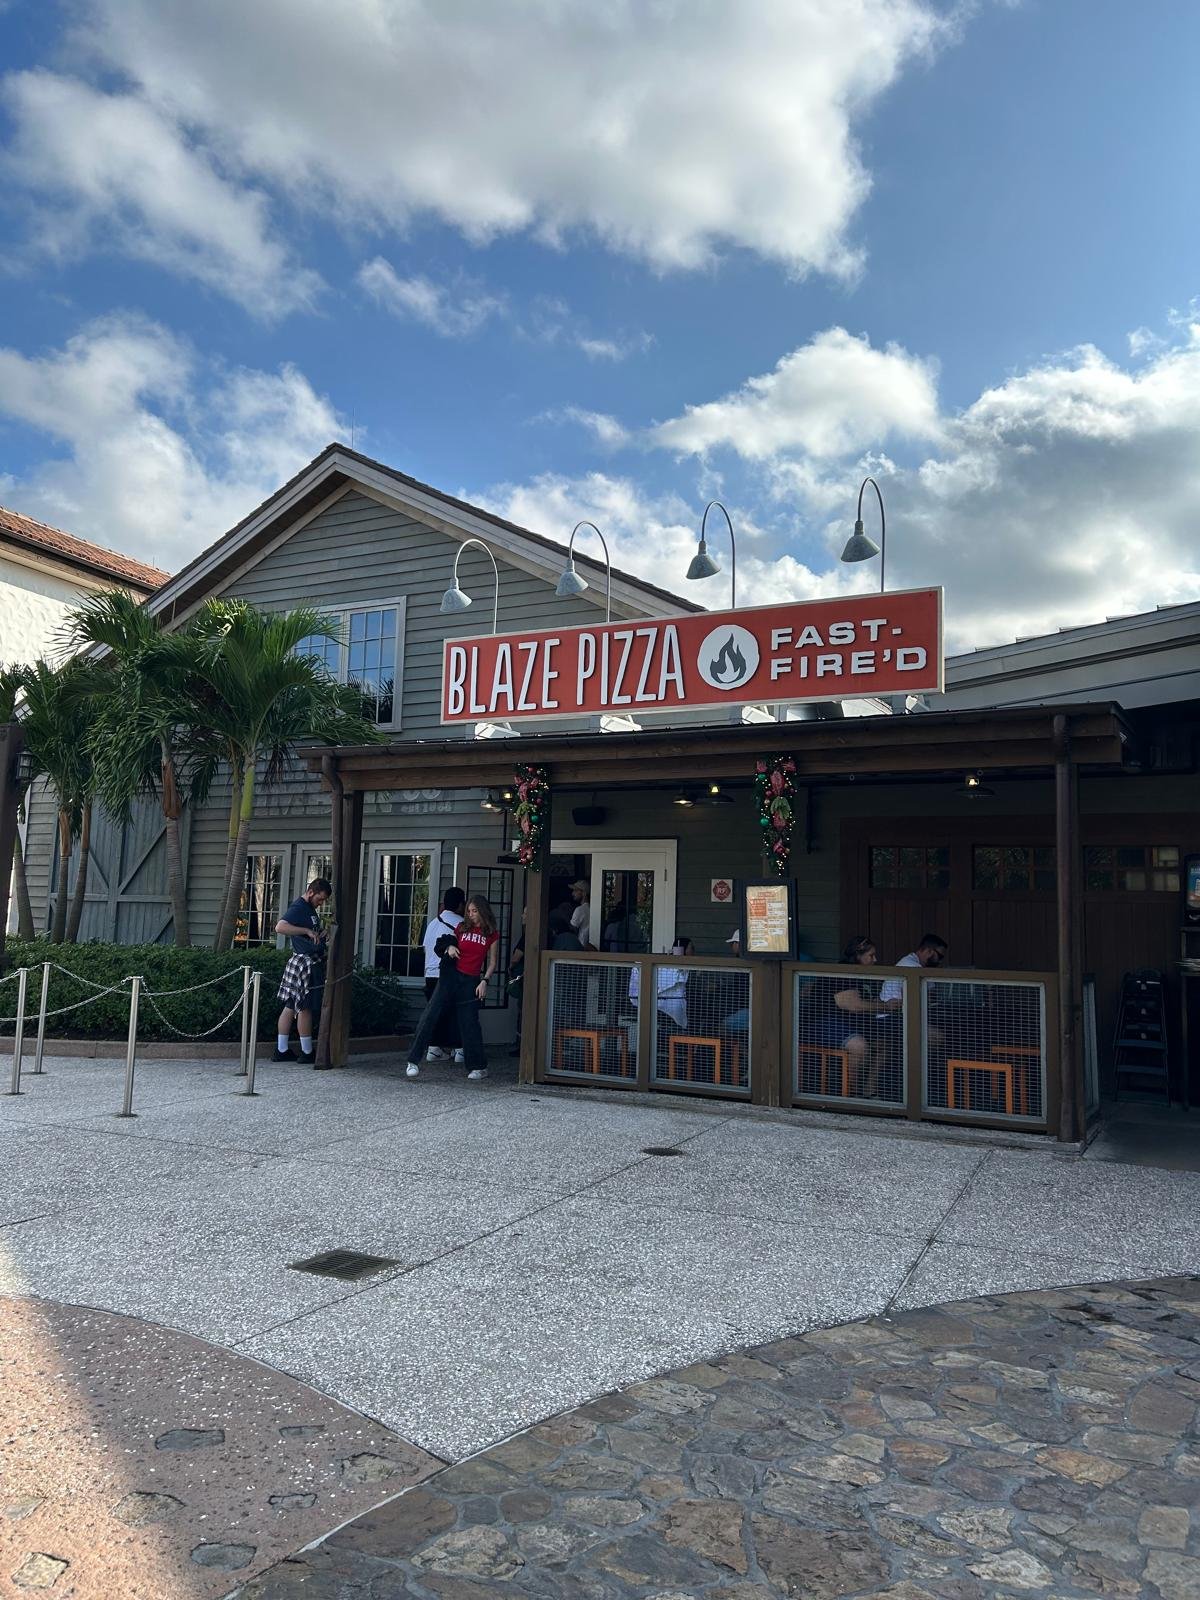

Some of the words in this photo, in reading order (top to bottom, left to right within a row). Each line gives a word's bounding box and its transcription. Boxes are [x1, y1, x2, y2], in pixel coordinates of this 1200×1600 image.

[771, 618, 902, 651] FAST-
[448, 638, 560, 715] BLAZE
[576, 624, 686, 706] PIZZA
[770, 646, 928, 681] FIRE'D
[460, 932, 487, 946] PARIS
